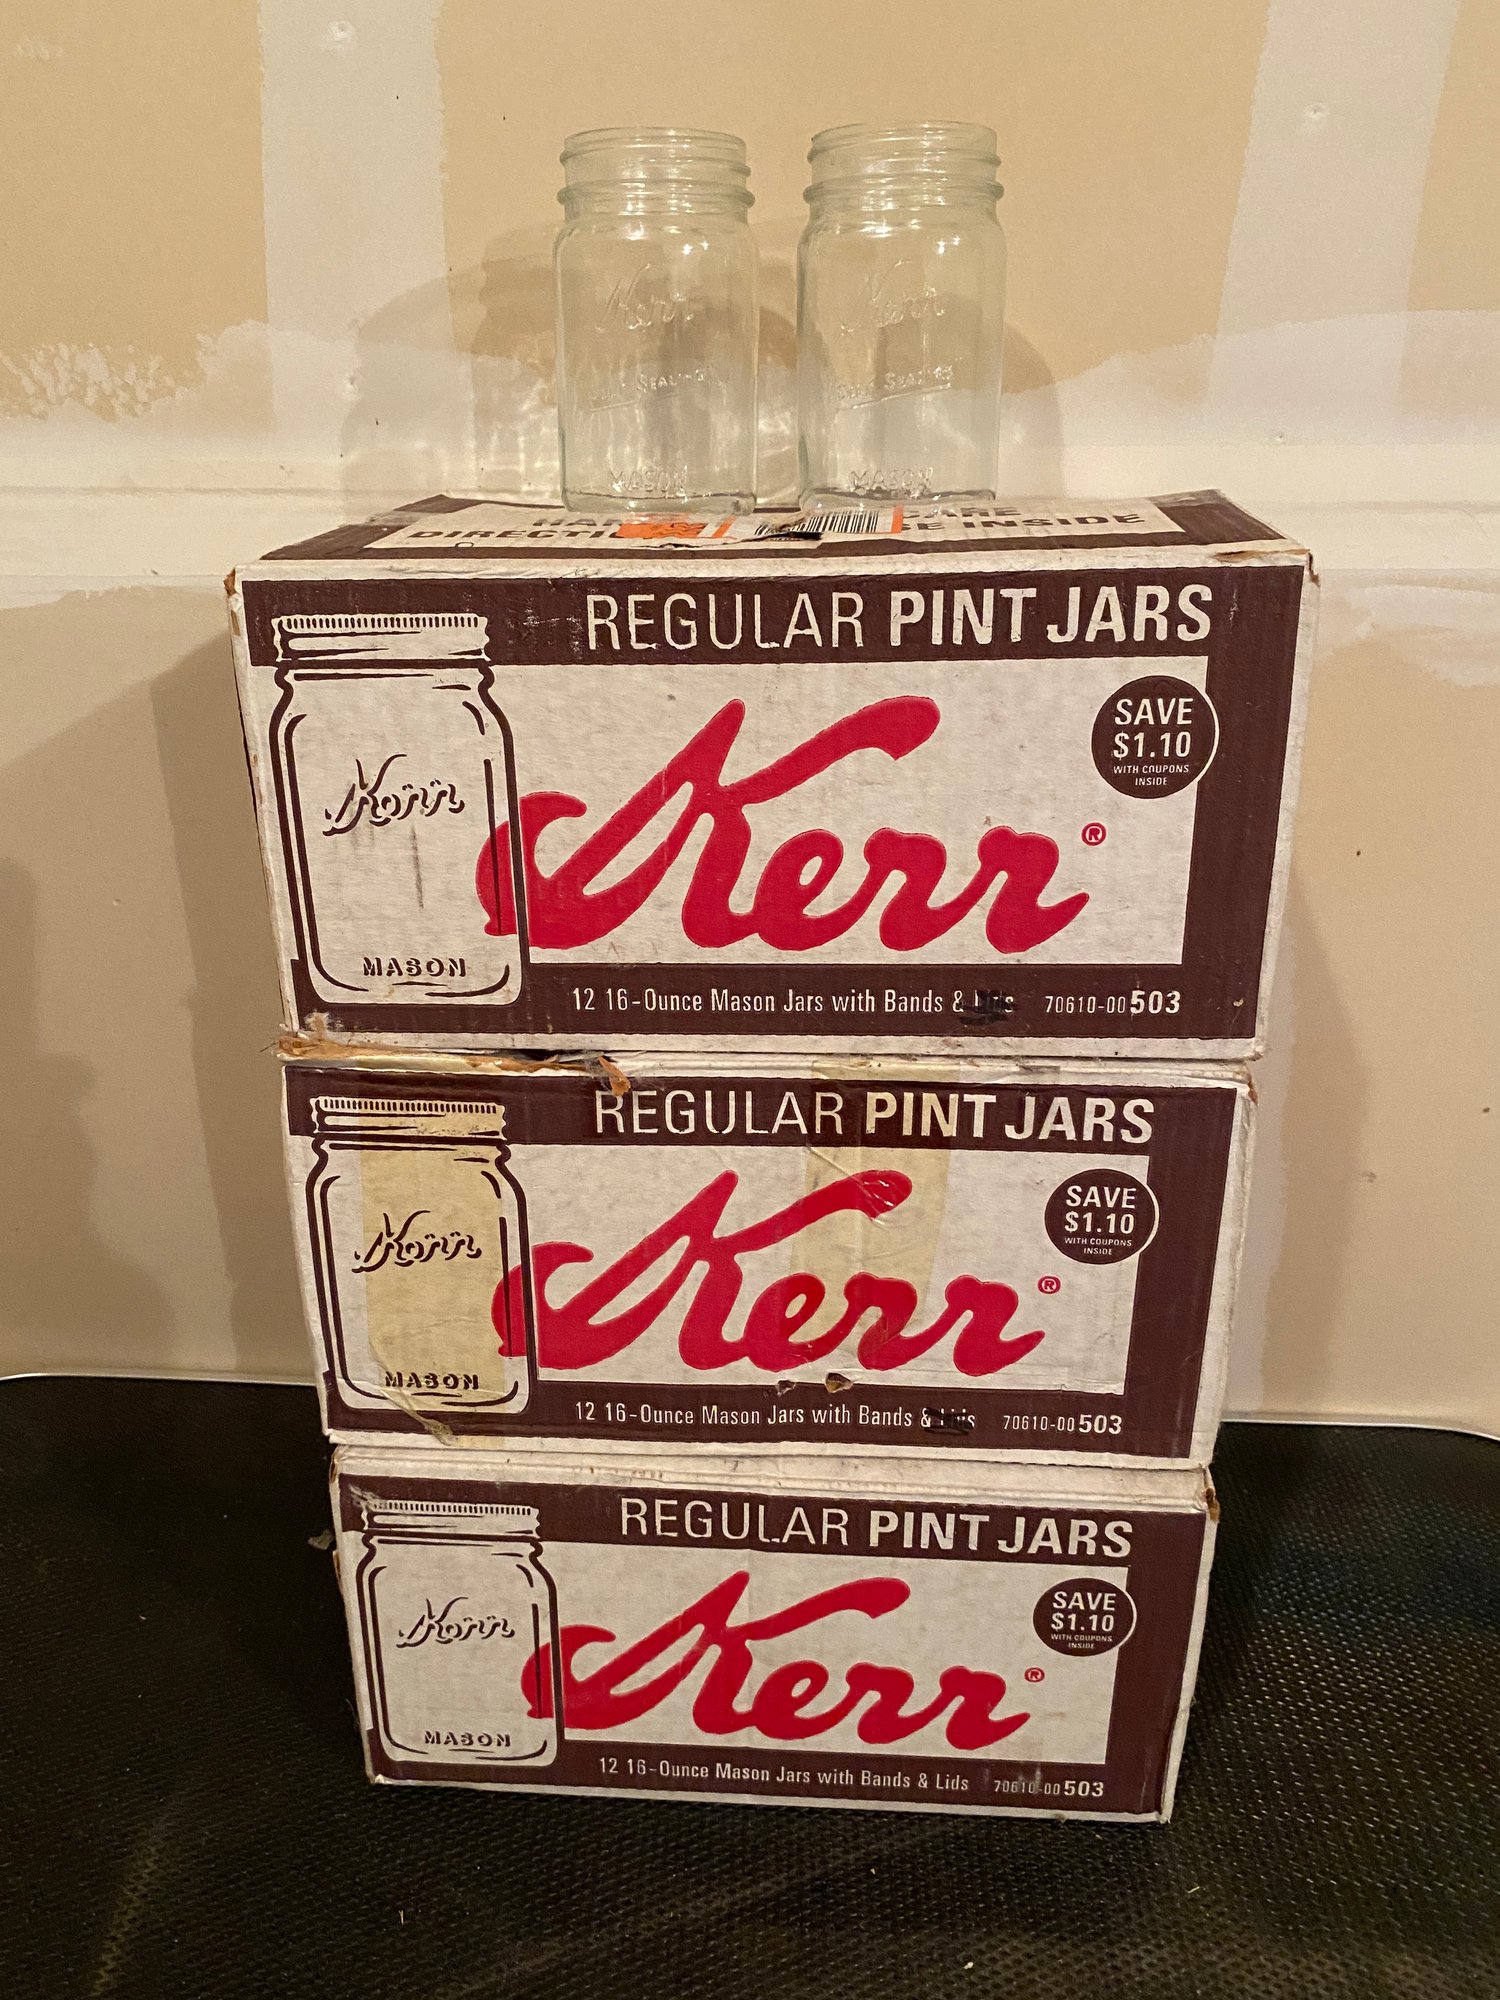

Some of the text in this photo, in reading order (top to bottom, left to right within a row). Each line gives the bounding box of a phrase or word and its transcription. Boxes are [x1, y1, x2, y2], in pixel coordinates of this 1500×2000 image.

[963, 513, 1145, 530] INSIDE
[587, 583, 1213, 651] REGULAR PINT JARS
[1114, 697, 1194, 726] SAVE
[1113, 730, 1192, 761] $1.10
[1113, 764, 1190, 774] WITH COUPONS
[1134, 776, 1168, 786] INSIDE
[475, 695, 1090, 954] Kerr
[363, 956, 467, 978] MASON
[572, 987, 596, 1011] 12
[711, 988, 775, 1012] Mason
[783, 989, 824, 1013] Jars
[831, 989, 876, 1013] with
[884, 989, 944, 1014] Bands
[952, 990, 965, 1013] &
[594, 1089, 1155, 1144] REGULAR PINT JARS
[1065, 1184, 1138, 1210] SAVE
[1064, 1210, 1136, 1234] $1.10
[1064, 1236, 1133, 1247] WITH COUPONS
[1083, 1248, 1113, 1256] INSIDE
[491, 1169, 1046, 1377] Kerr
[384, 1370, 480, 1391] MASON
[575, 1401, 596, 1422] 12
[701, 1404, 761, 1425] Mason
[767, 1404, 805, 1425] Jars
[811, 1403, 851, 1425] with
[858, 1404, 913, 1427] Bands
[920, 1406, 932, 1428] &
[620, 1496, 1134, 1559] REGULAR PINT JARS
[1052, 1590, 1117, 1611] SAVE
[1050, 1611, 1115, 1632] $1.10
[1050, 1633, 1113, 1642] WITH COUPONS
[1068, 1642, 1095, 1650] INSIDE
[521, 1569, 1031, 1751] Kerr
[424, 1730, 512, 1748] MASON
[599, 1756, 619, 1775] 12
[715, 1762, 770, 1782] Mason
[776, 1765, 811, 1783] Jars
[817, 1768, 854, 1785] with
[860, 1769, 911, 1788] Bands
[917, 1771, 928, 1789] &
[935, 1772, 969, 1791] Lids
